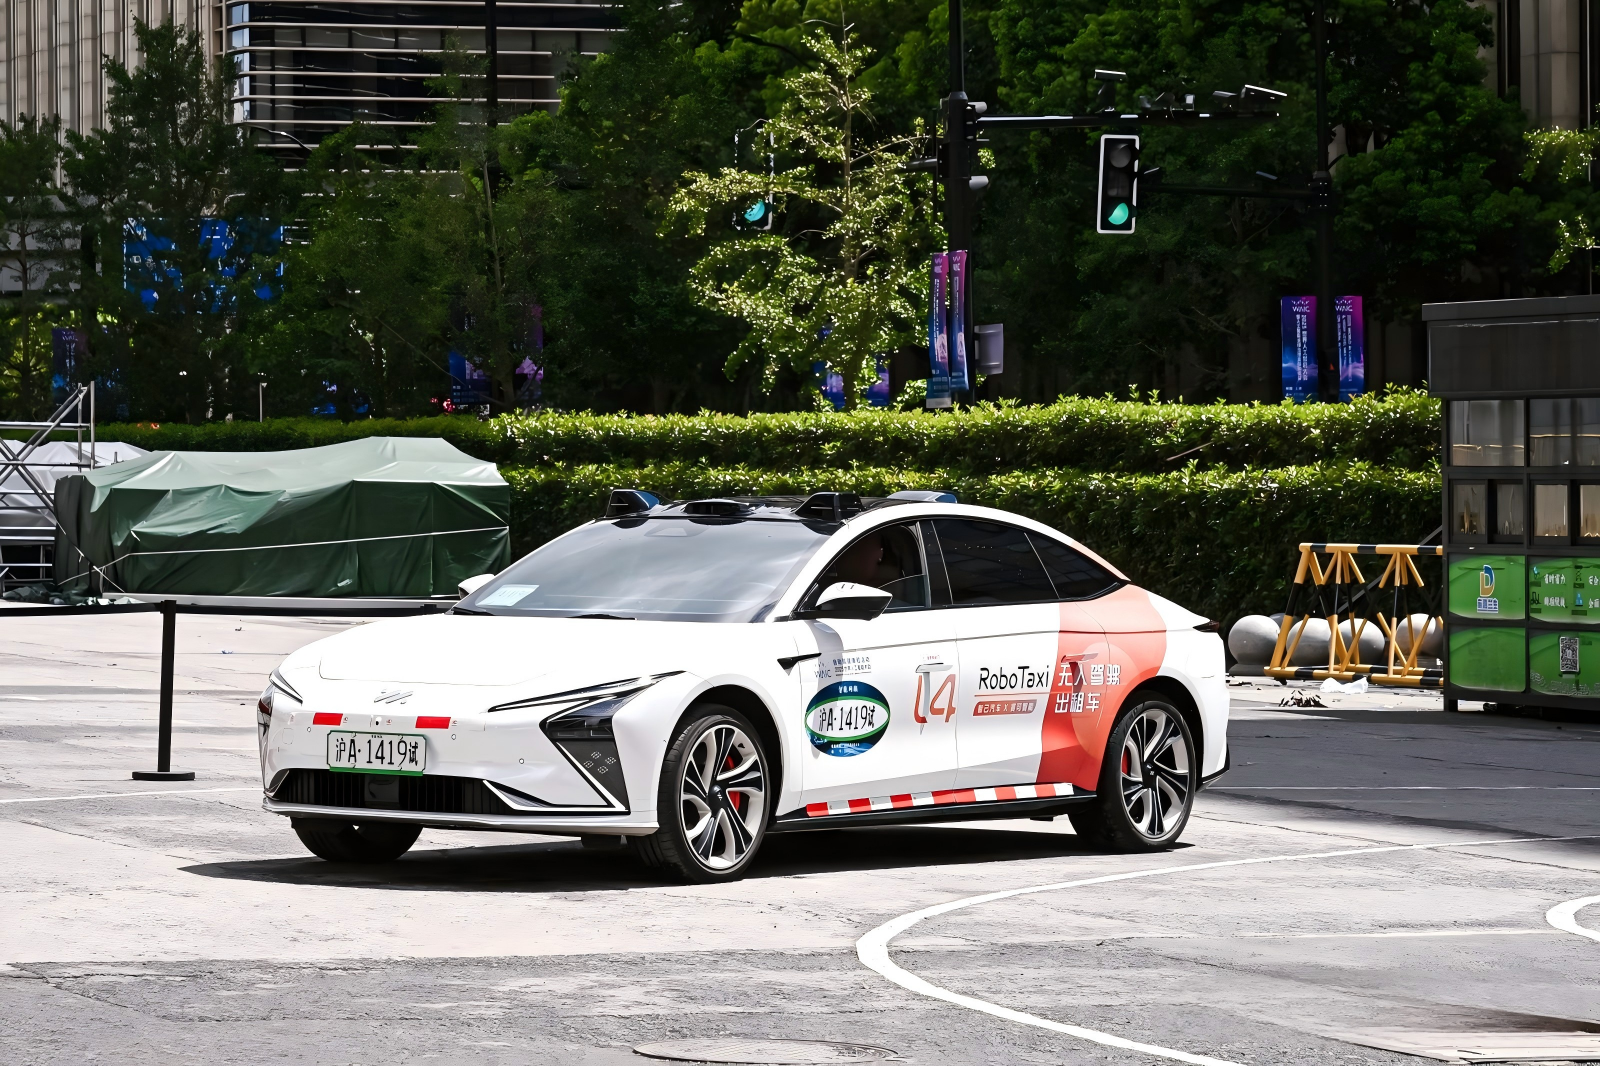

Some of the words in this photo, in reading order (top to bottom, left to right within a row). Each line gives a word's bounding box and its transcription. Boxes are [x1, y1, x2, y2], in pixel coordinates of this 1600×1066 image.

[979, 665, 1049, 690] RoboTaxi
[1057, 662, 1121, 687] 无人驾驶
[1054, 692, 1101, 713] 出租车
